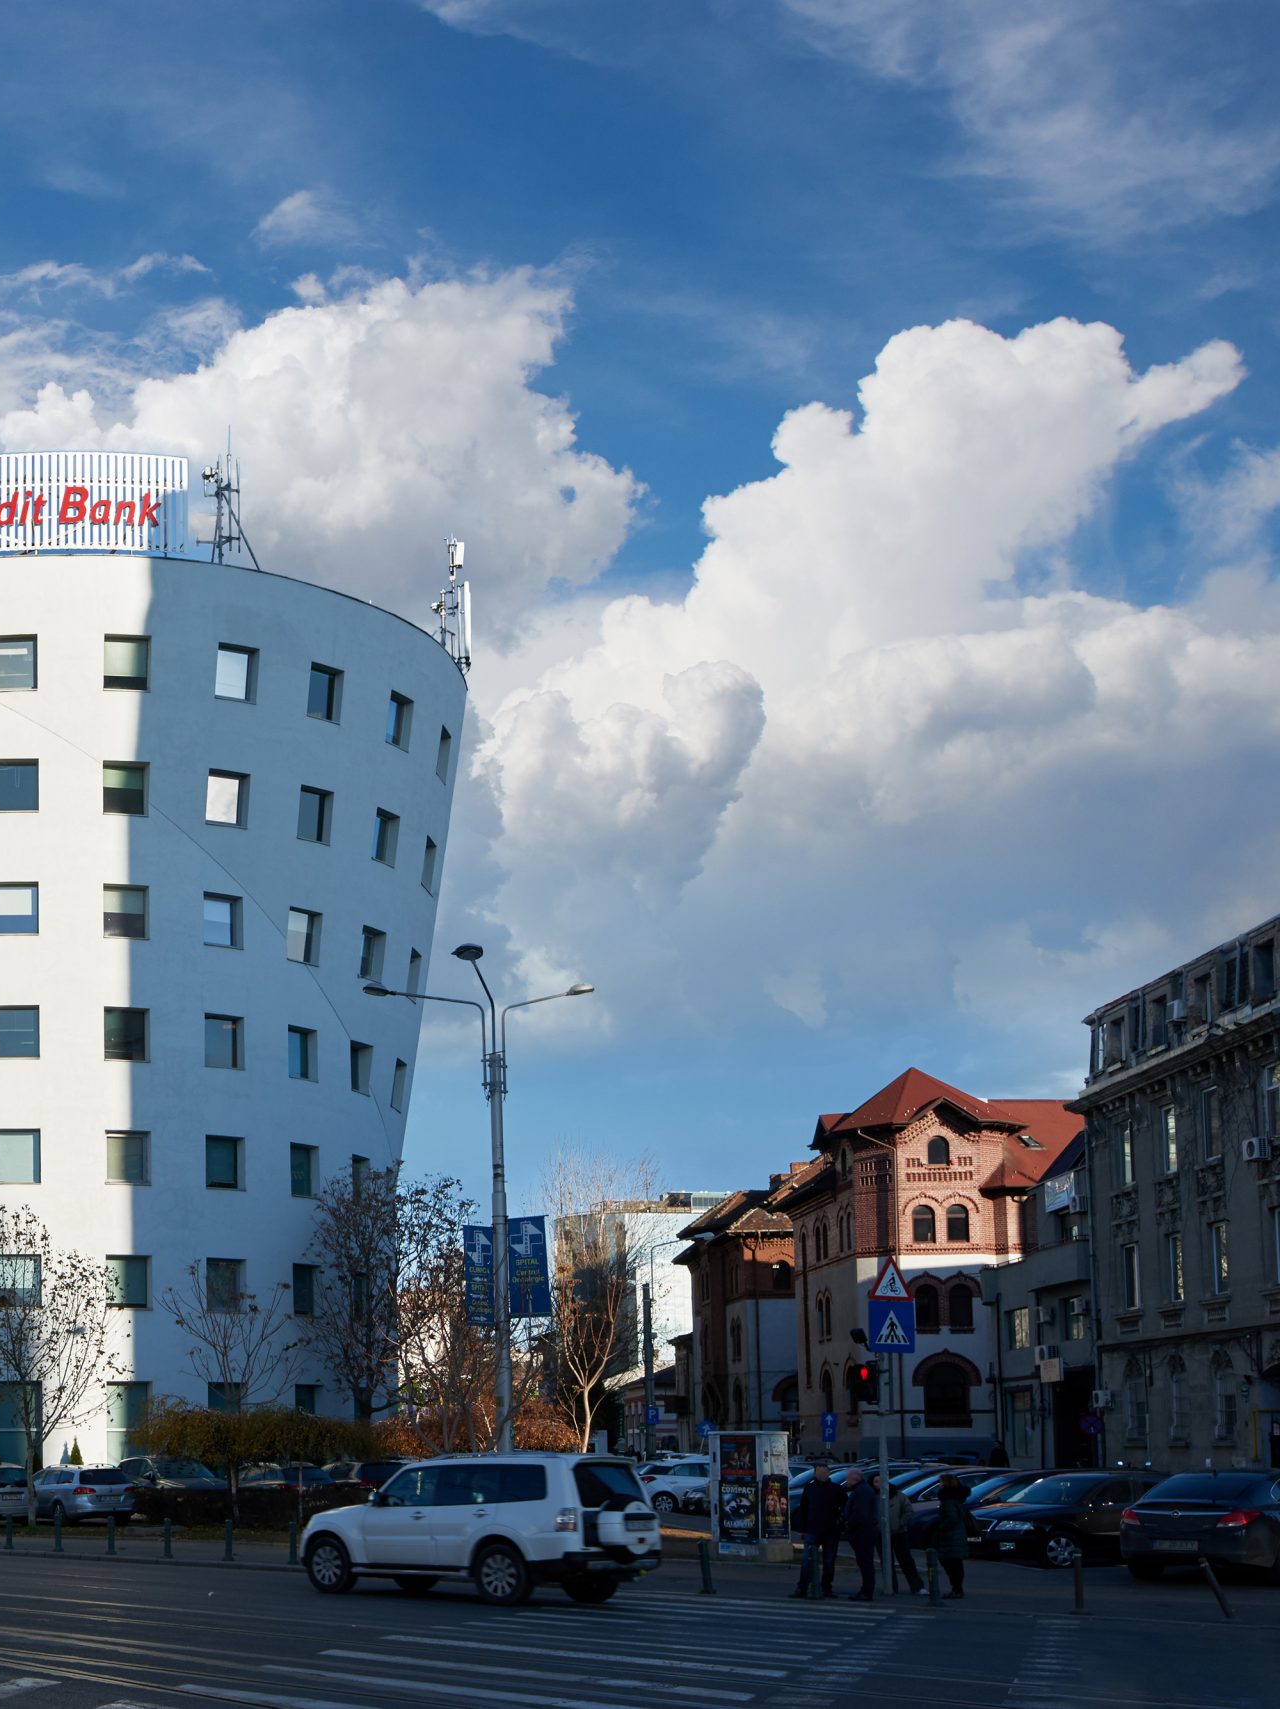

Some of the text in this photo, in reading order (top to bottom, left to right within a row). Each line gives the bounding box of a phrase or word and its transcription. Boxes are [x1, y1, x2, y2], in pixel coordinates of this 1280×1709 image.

[59, 486, 162, 527] Bank
[649, 1409, 656, 1419] P
[825, 1427, 833, 1437] P
[721, 1486, 756, 1494] COMPACT
